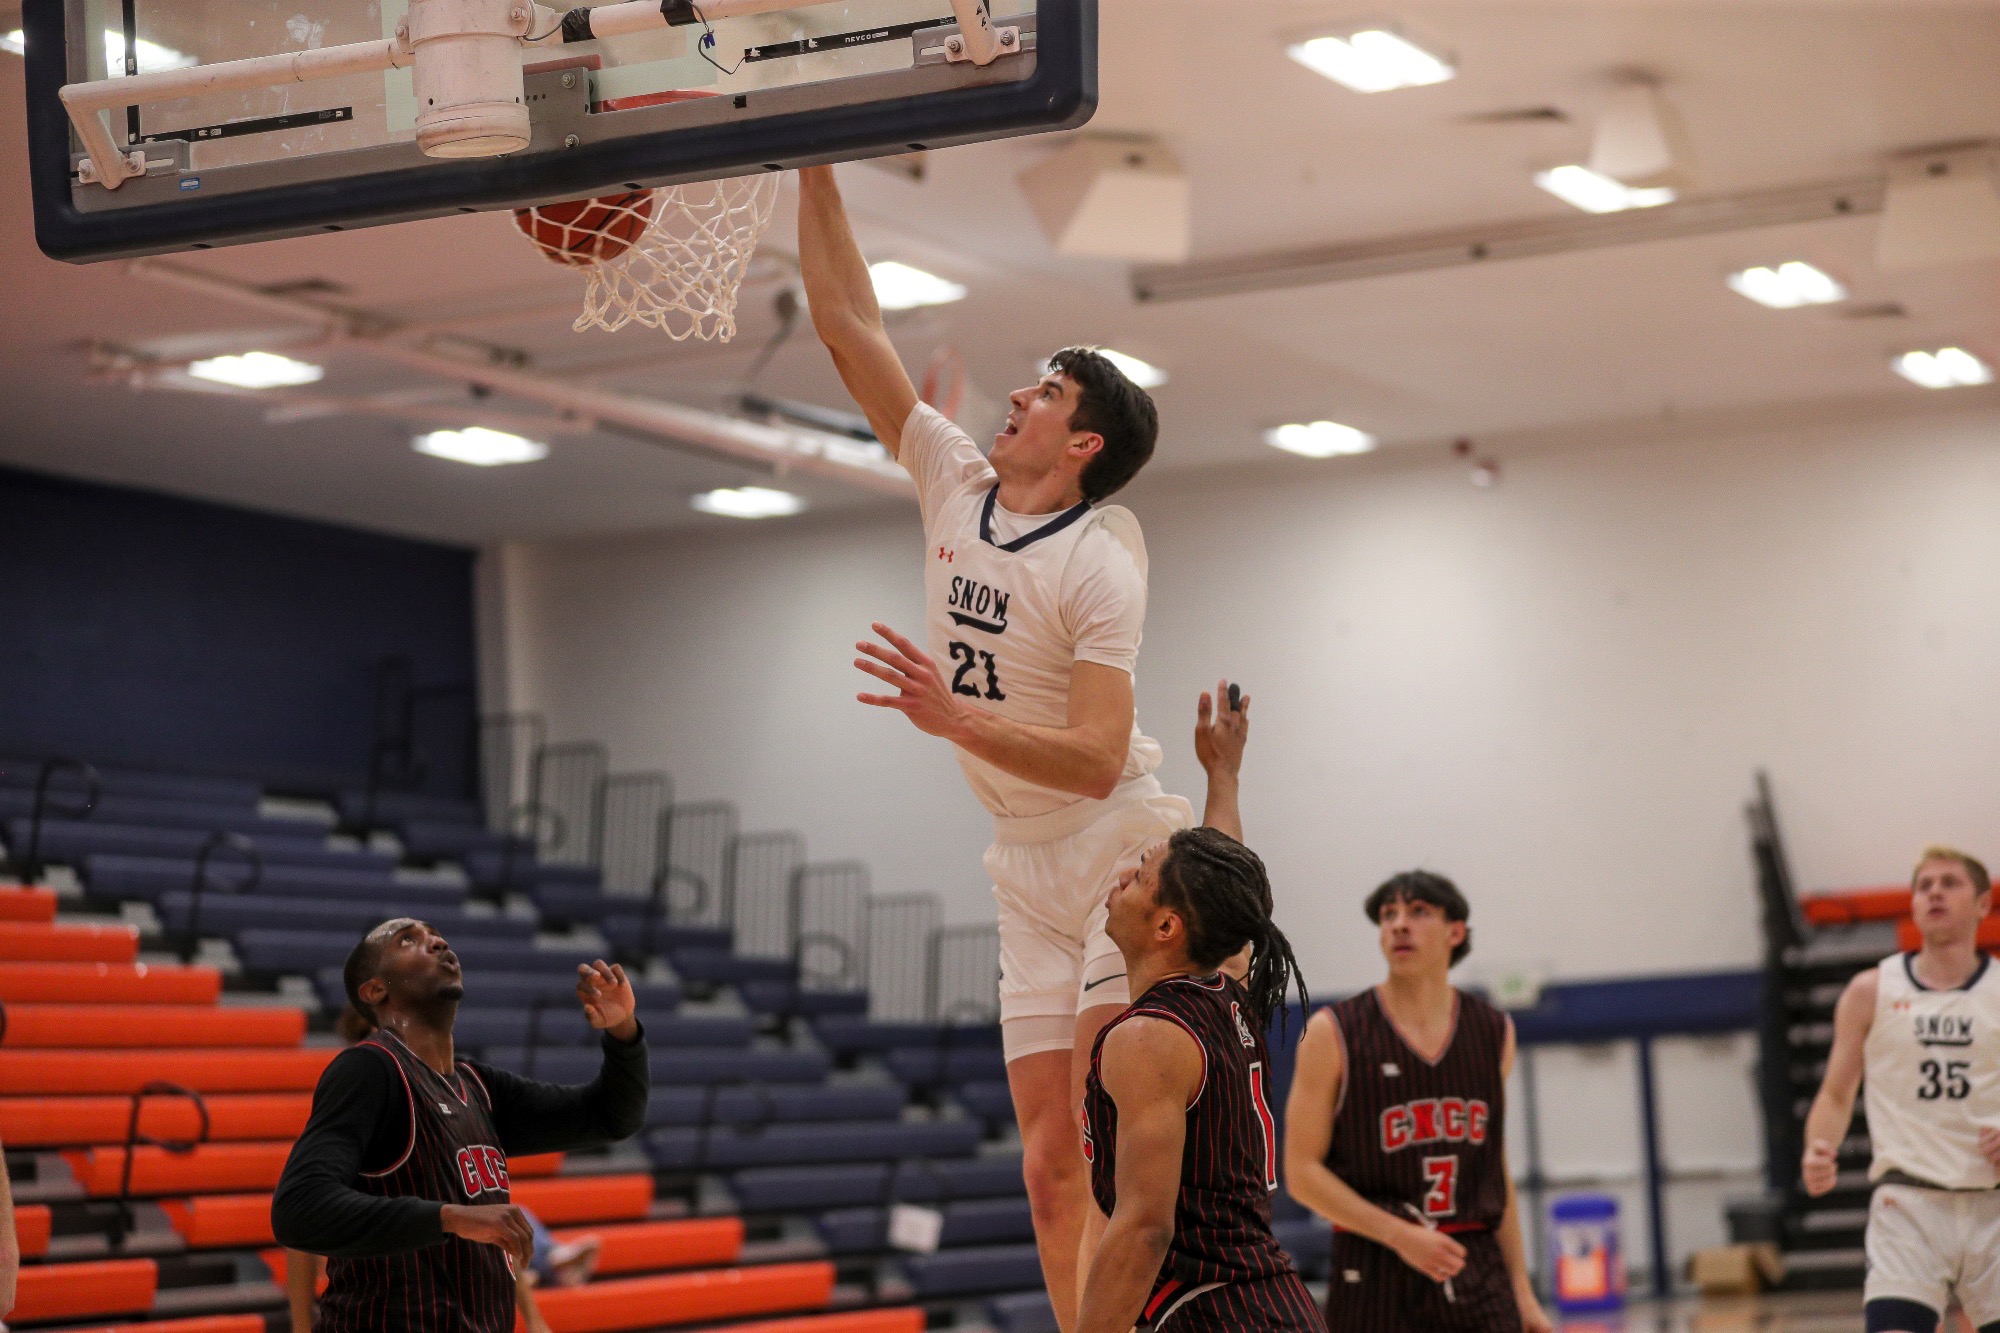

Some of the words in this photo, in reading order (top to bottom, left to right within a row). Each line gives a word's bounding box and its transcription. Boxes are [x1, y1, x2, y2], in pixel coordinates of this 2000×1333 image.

[948, 575, 1011, 621] SNOW
[948, 640, 1007, 702] 21
[1914, 1014, 1974, 1037] SNOW
[1917, 1059, 1971, 1101] 35
[1379, 1096, 1489, 1154] CNCC
[456, 1144, 510, 1199] CNC
[1422, 1154, 1459, 1218] 3
